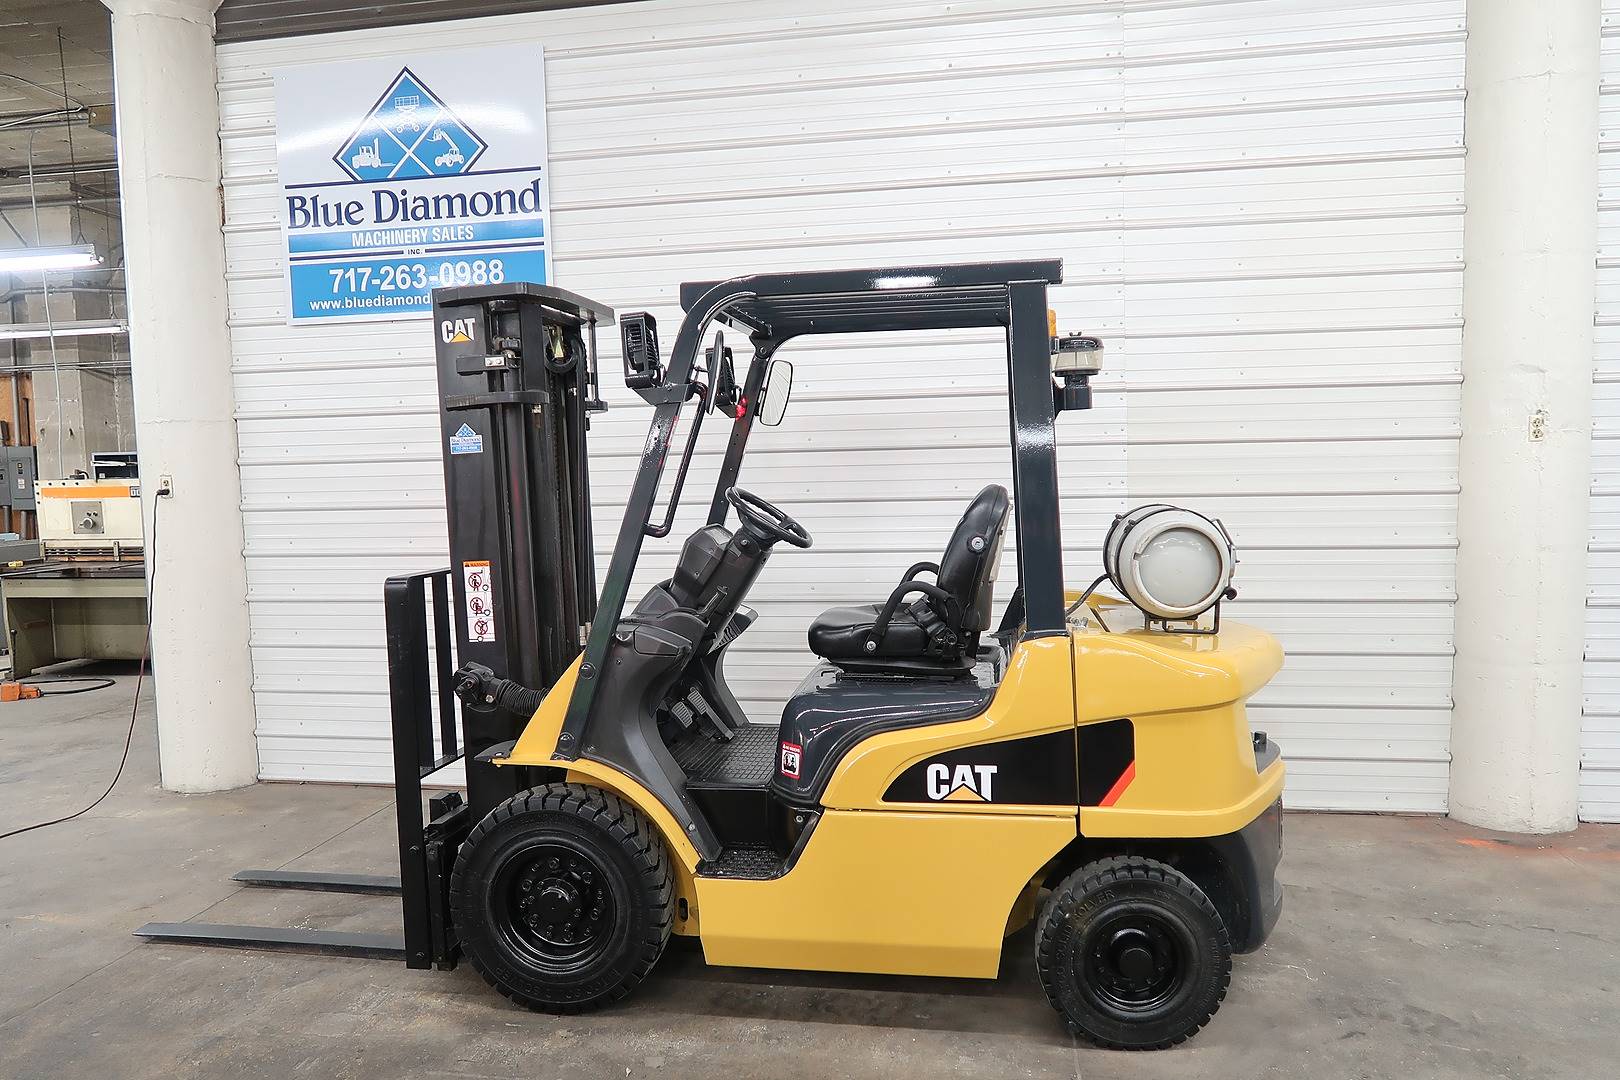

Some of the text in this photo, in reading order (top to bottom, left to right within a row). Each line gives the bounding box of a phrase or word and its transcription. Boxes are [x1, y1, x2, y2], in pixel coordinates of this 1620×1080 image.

[286, 177, 543, 229] Blue Diamond
[351, 225, 474, 248] MACHINERY SALES
[407, 247, 423, 255] INC.
[328, 259, 505, 293] 717-263-0988
[441, 318, 476, 343] CAT
[926, 763, 998, 802] CAT
